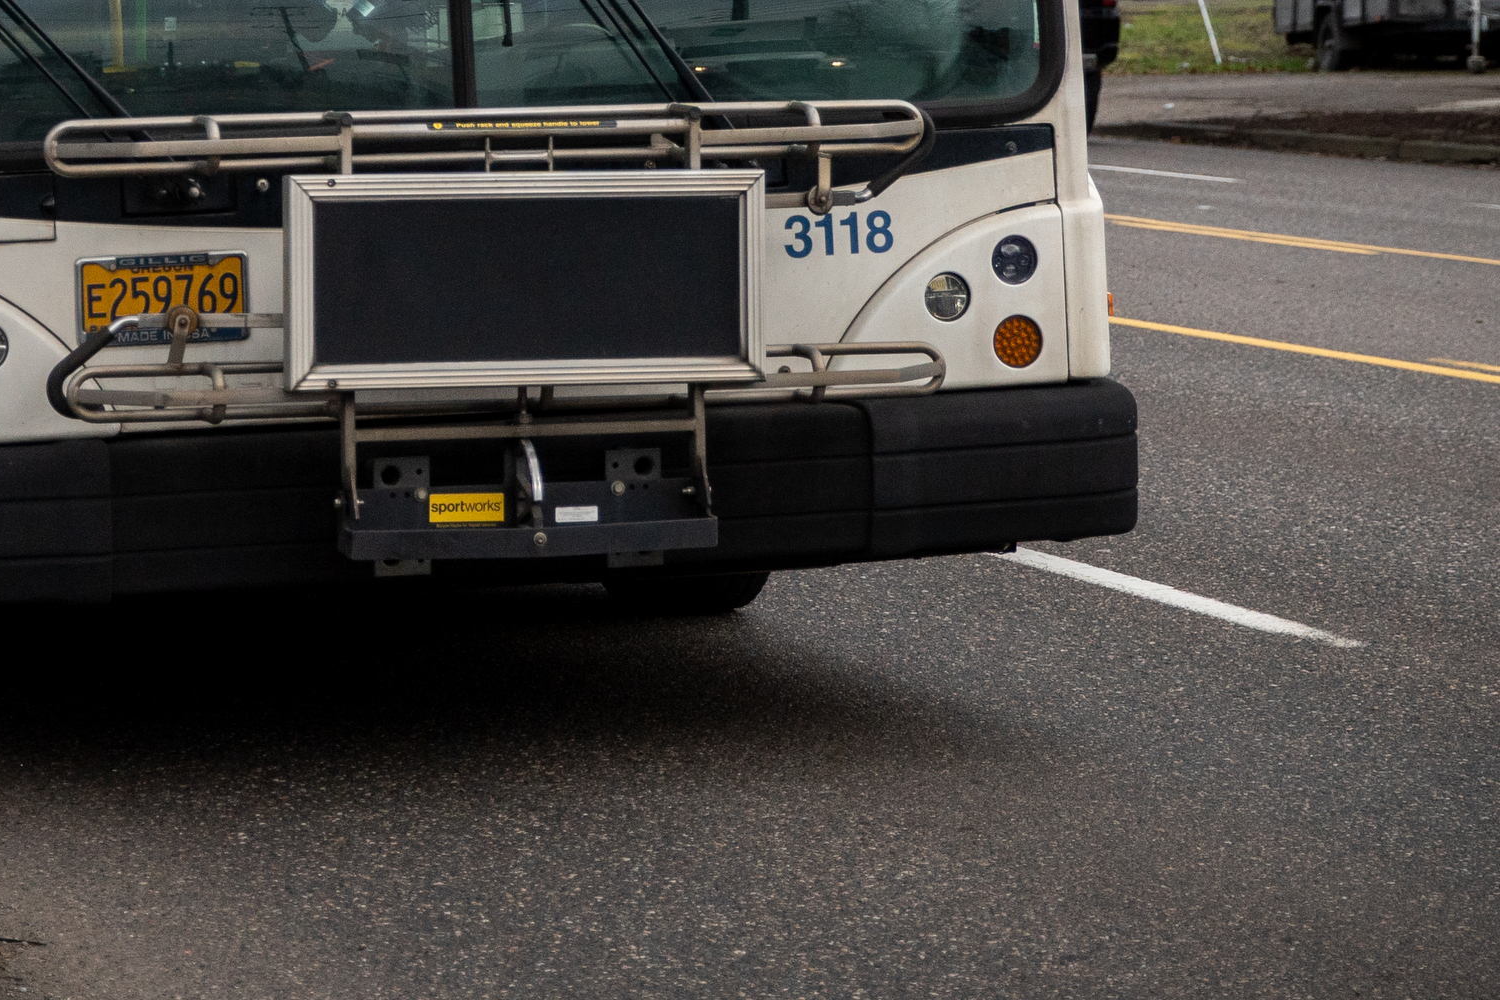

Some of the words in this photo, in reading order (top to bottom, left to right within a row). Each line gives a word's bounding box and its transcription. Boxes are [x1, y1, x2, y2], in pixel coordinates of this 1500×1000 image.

[784, 209, 894, 258] 3118
[119, 255, 206, 266] GILLIG
[87, 272, 238, 319] E259769
[117, 330, 157, 343] MADE
[188, 327, 210, 339] SA
[431, 500, 501, 515] sportworks
